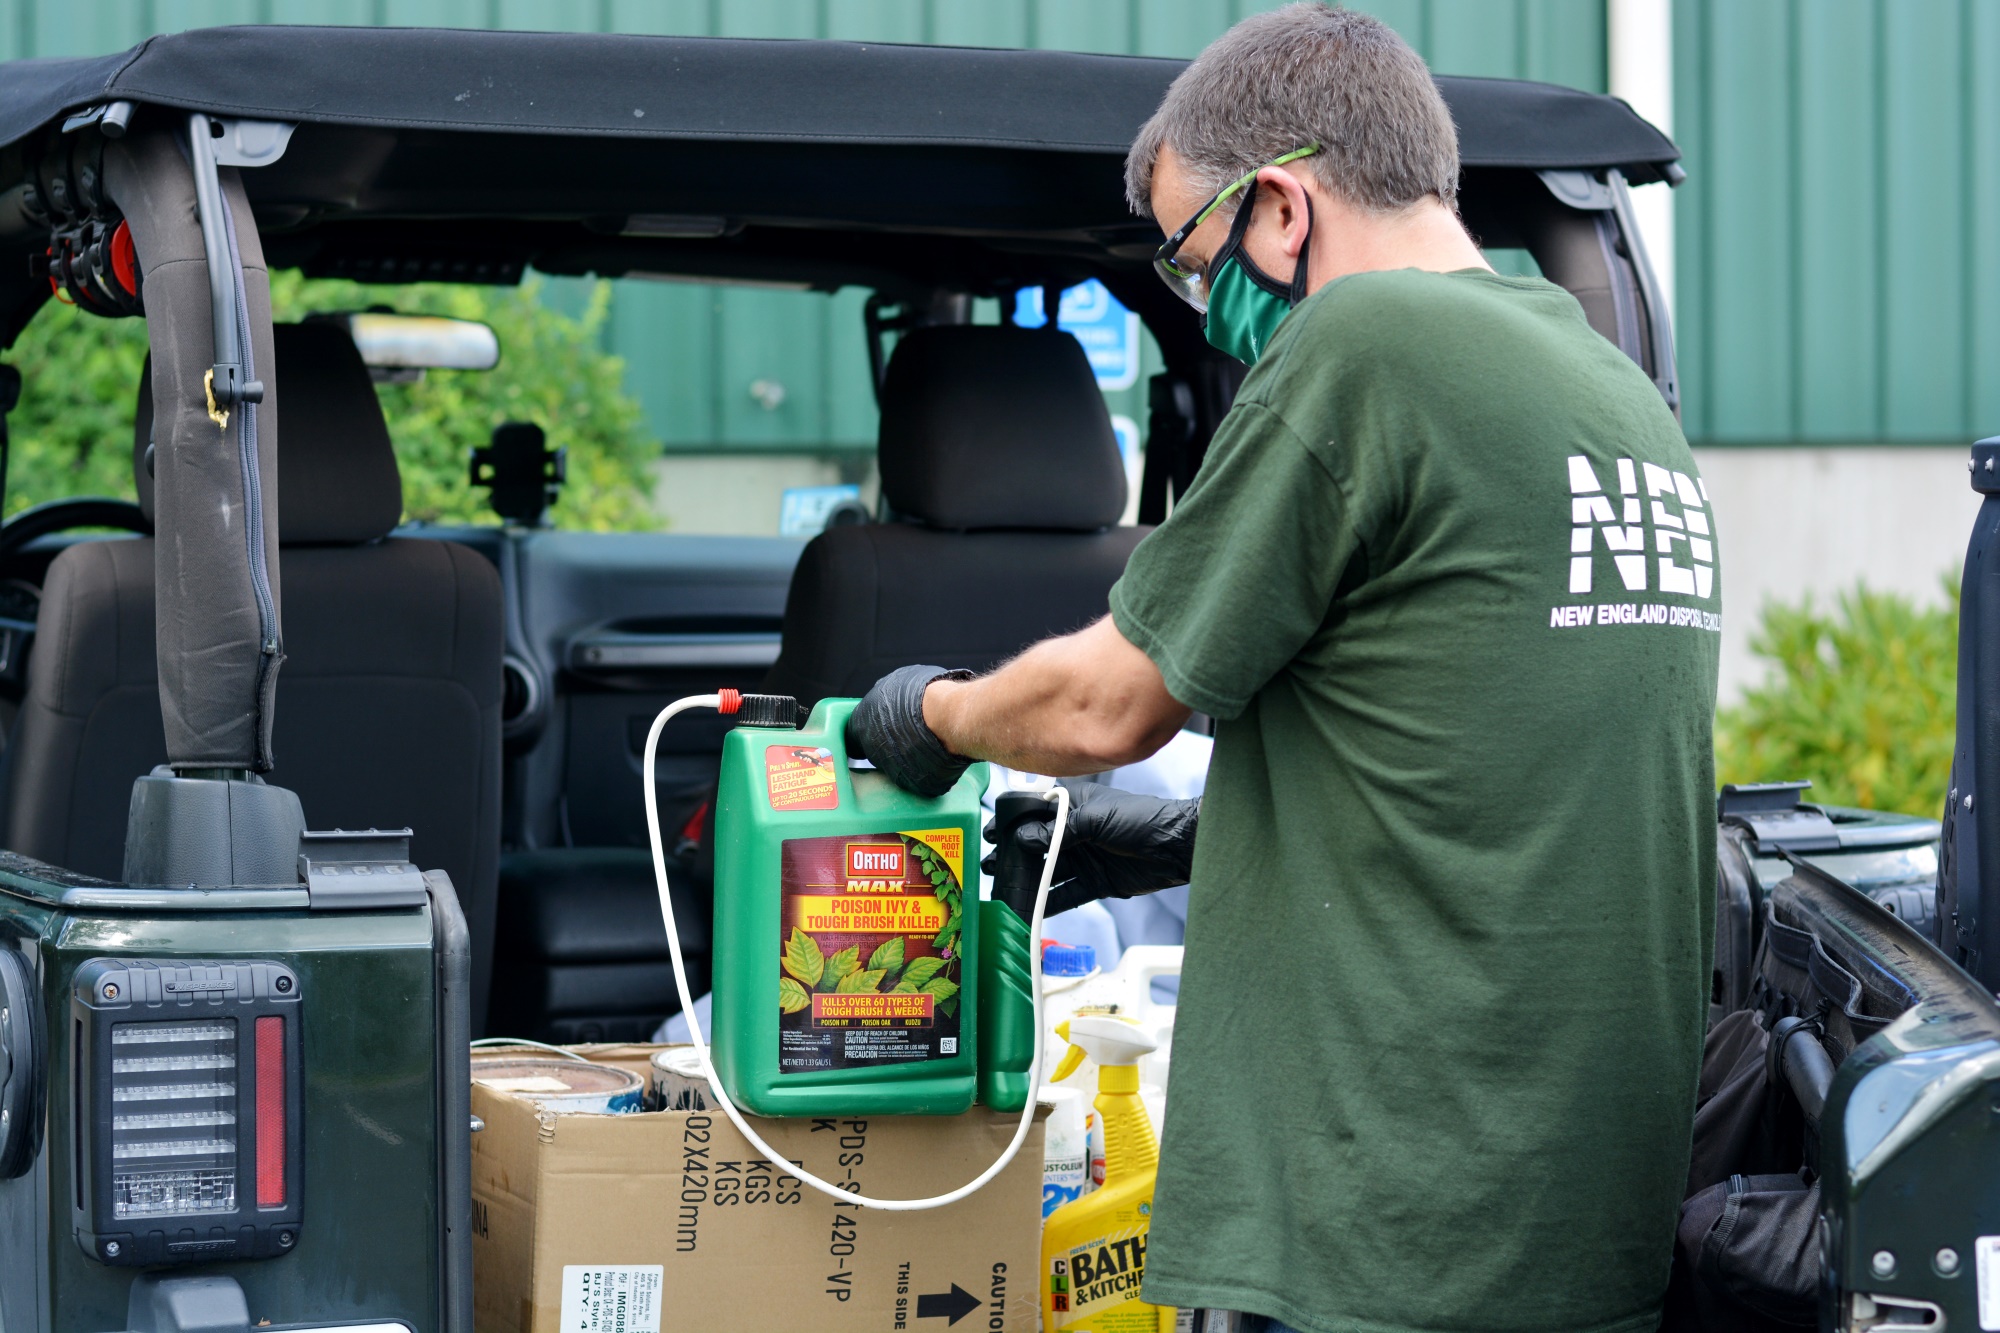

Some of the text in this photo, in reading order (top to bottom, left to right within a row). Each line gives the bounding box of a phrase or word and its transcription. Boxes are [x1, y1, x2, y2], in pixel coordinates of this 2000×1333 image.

[1550, 606, 1594, 628] NEW
[1597, 604, 1668, 626] ENGLAND
[772, 769, 816, 783] LESS HAND
[773, 778, 807, 792] FATIGUE
[788, 791, 798, 799] 20
[798, 785, 834, 797] SECONDS
[780, 794, 814, 806] CONTINUOUS
[815, 791, 831, 799] SPRAY
[853, 850, 898, 870] ORTHO
[846, 880, 905, 893] MAX
[831, 900, 921, 914] POISON IVY &
[807, 915, 940, 928] TOUGH BRUSH KILLER
[822, 997, 925, 1006] KILLS OVER 60 TYPES OF
[821, 1007, 925, 1016] TOUGH BRUSH & WEEDS:
[845, 1036, 868, 1044] CAUTION
[713, 1161, 741, 1206] KGS
[744, 1160, 772, 1204] KGS
[1069, 1238, 1106, 1255] FRESH SCENT
[1071, 1233, 1148, 1288] BATH
[894, 1261, 910, 1330] THIS SIDE
[1075, 1270, 1144, 1306] & KITCHE
[1124, 1289, 1141, 1300] CLEA
[580, 1272, 590, 1330] QTY: 4
[591, 1272, 602, 1332] BJ'S Style:
[989, 1262, 1007, 1333] CAUTIO
